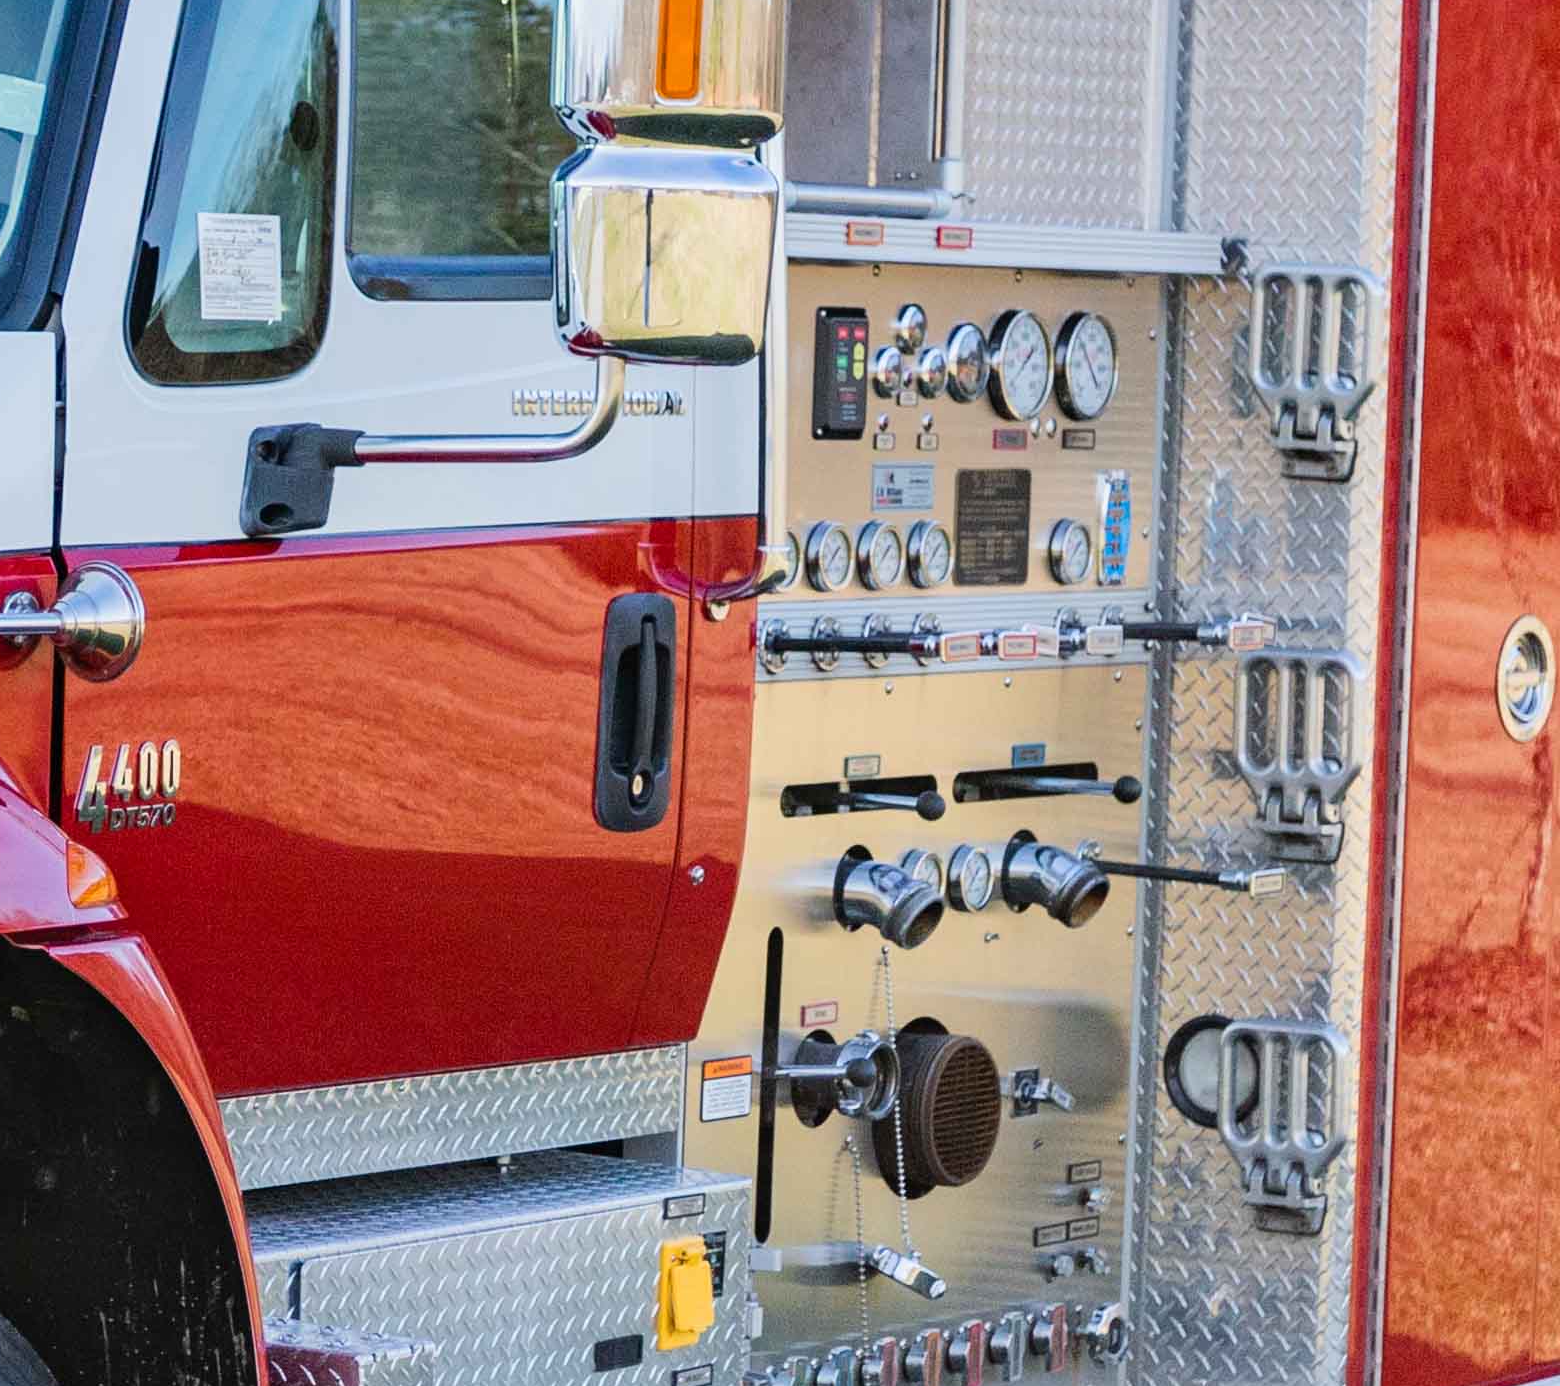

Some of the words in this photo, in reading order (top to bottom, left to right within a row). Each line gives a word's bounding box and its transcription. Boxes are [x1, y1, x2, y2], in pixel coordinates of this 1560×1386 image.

[512, 388, 686, 417] INTERNIONAL
[74, 739, 181, 833] 4400
[110, 803, 177, 831] DT570
